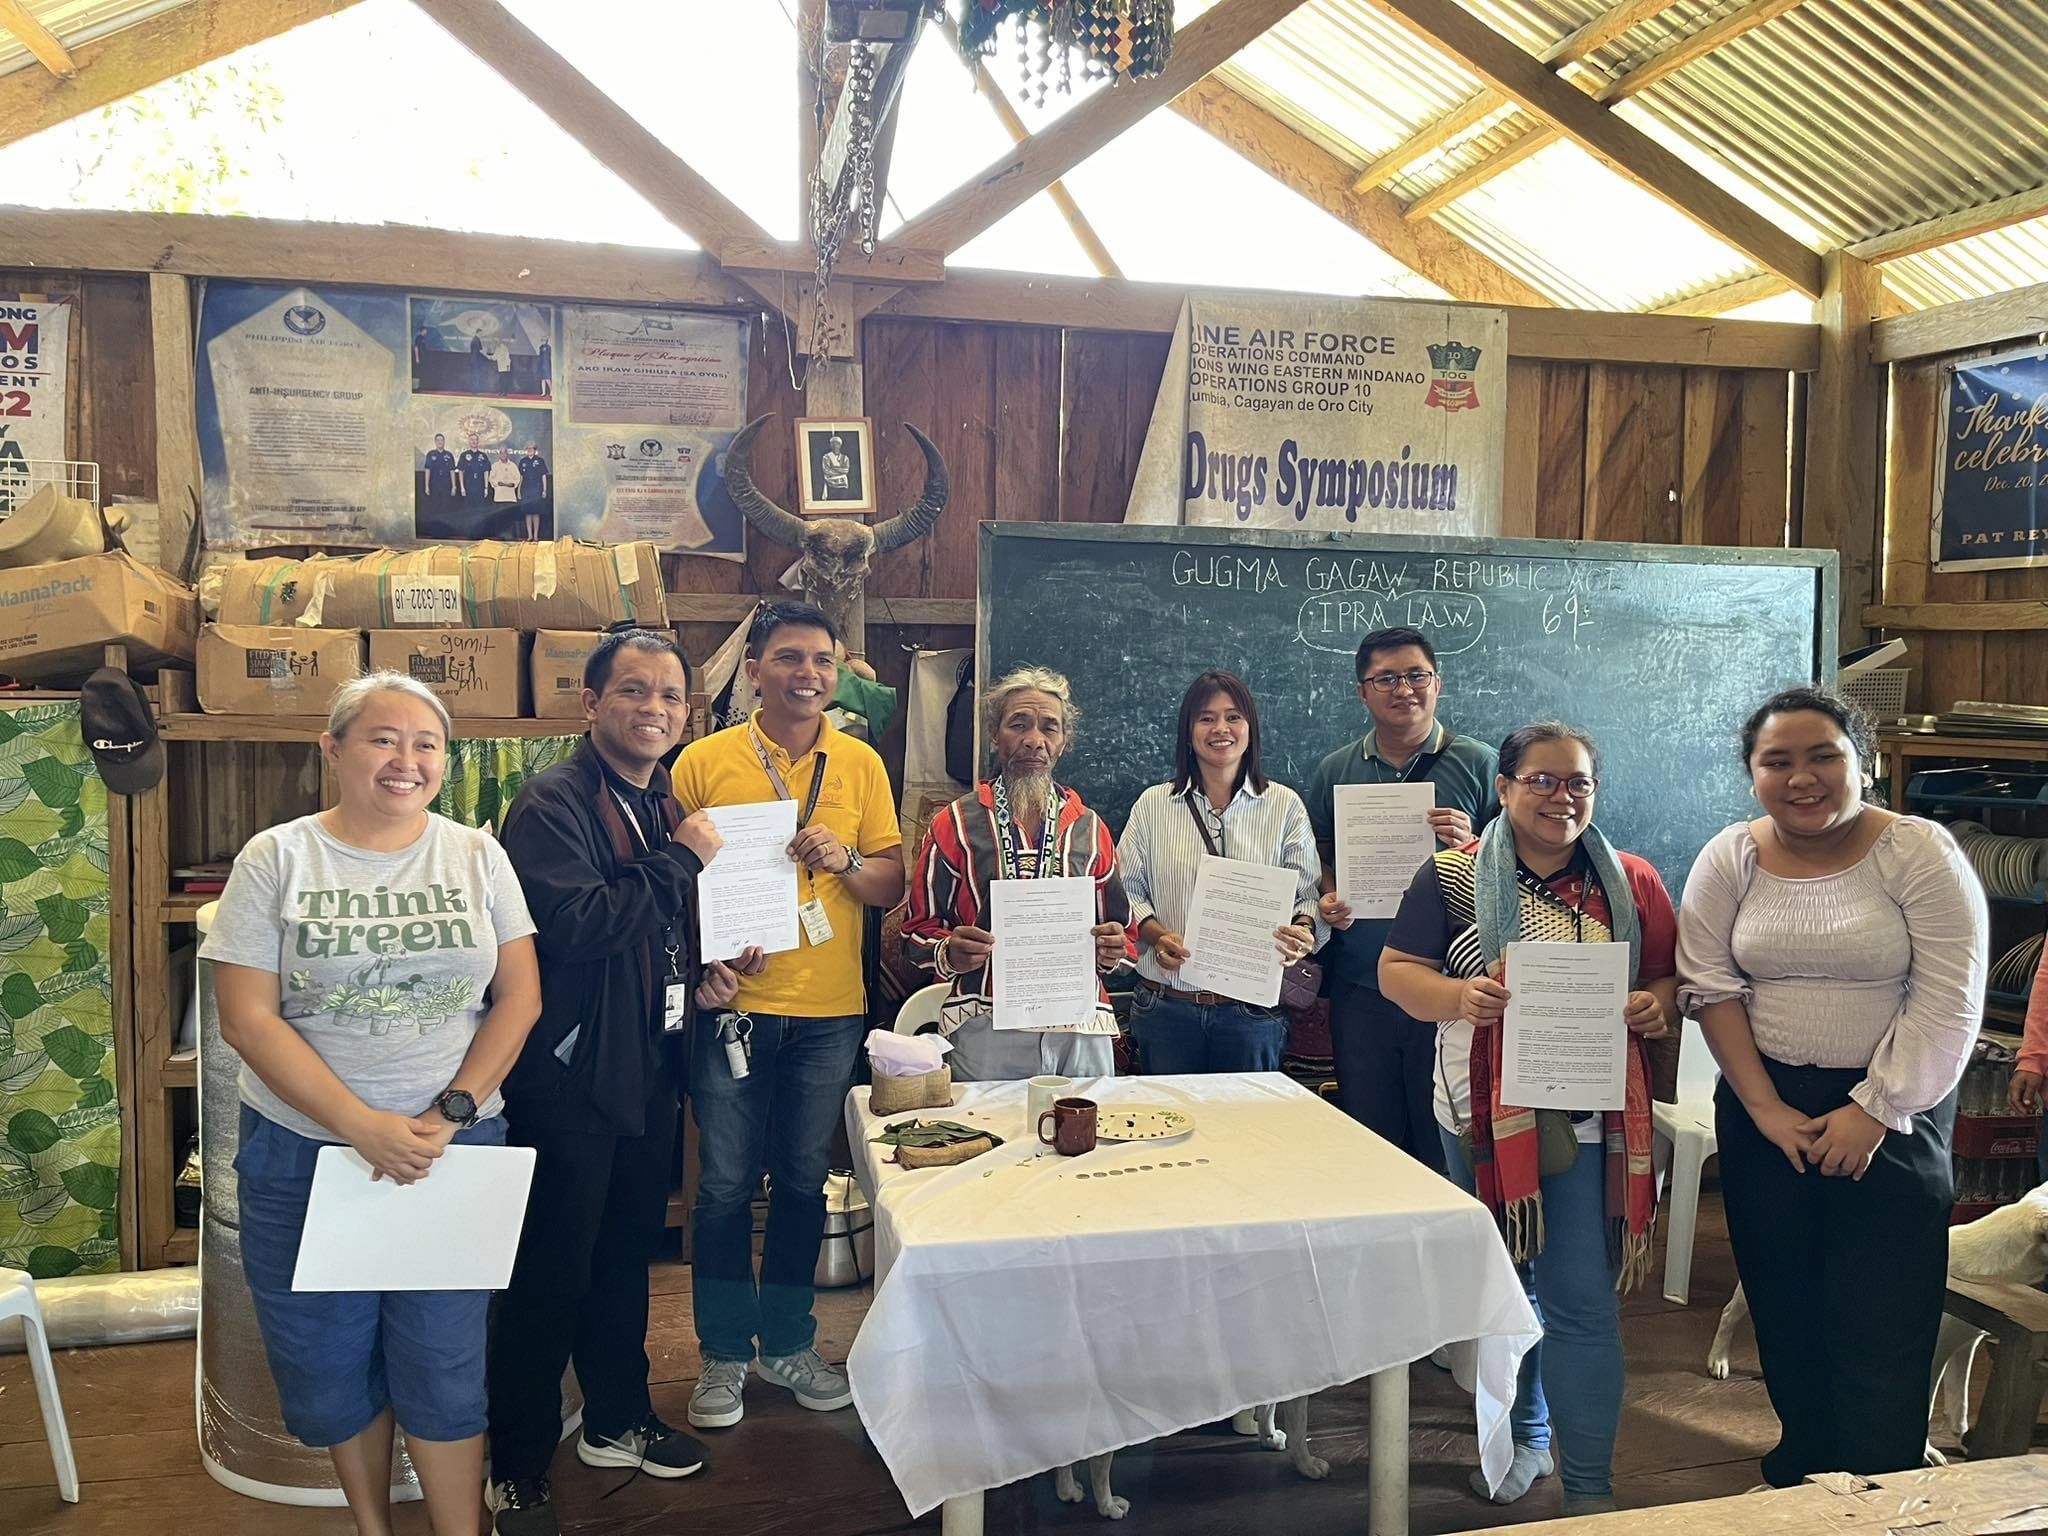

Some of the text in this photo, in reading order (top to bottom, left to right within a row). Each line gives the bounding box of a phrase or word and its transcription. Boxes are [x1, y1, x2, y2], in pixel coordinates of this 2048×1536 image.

[1190, 342, 1365, 367] OPERATIONS COMMAND
[1248, 328, 1295, 350] AIR
[1303, 332, 1396, 355] FORCE
[1190, 371, 1371, 398] OPERATIONS GROUP 10
[1192, 357, 1425, 385] IONS WING EASTERN MINDANAO
[1439, 370, 1468, 380] TOG
[0, 390, 32, 417] 2
[1190, 391, 1374, 416] umbia, Cagayan de Oro City
[1956, 392, 2048, 440] Thank
[1954, 424, 2048, 472] celebr
[1185, 430, 1458, 524] Drugs Symposium
[1961, 532, 2004, 545] PAT
[1172, 550, 1288, 594] GUGMA
[1305, 557, 1408, 591] GAGAW
[1432, 558, 1549, 592] REPUBLIC
[1318, 600, 1392, 633] IPRA
[440, 634, 496, 655] gamit
[297, 883, 468, 919] Think
[295, 918, 478, 959] Green
